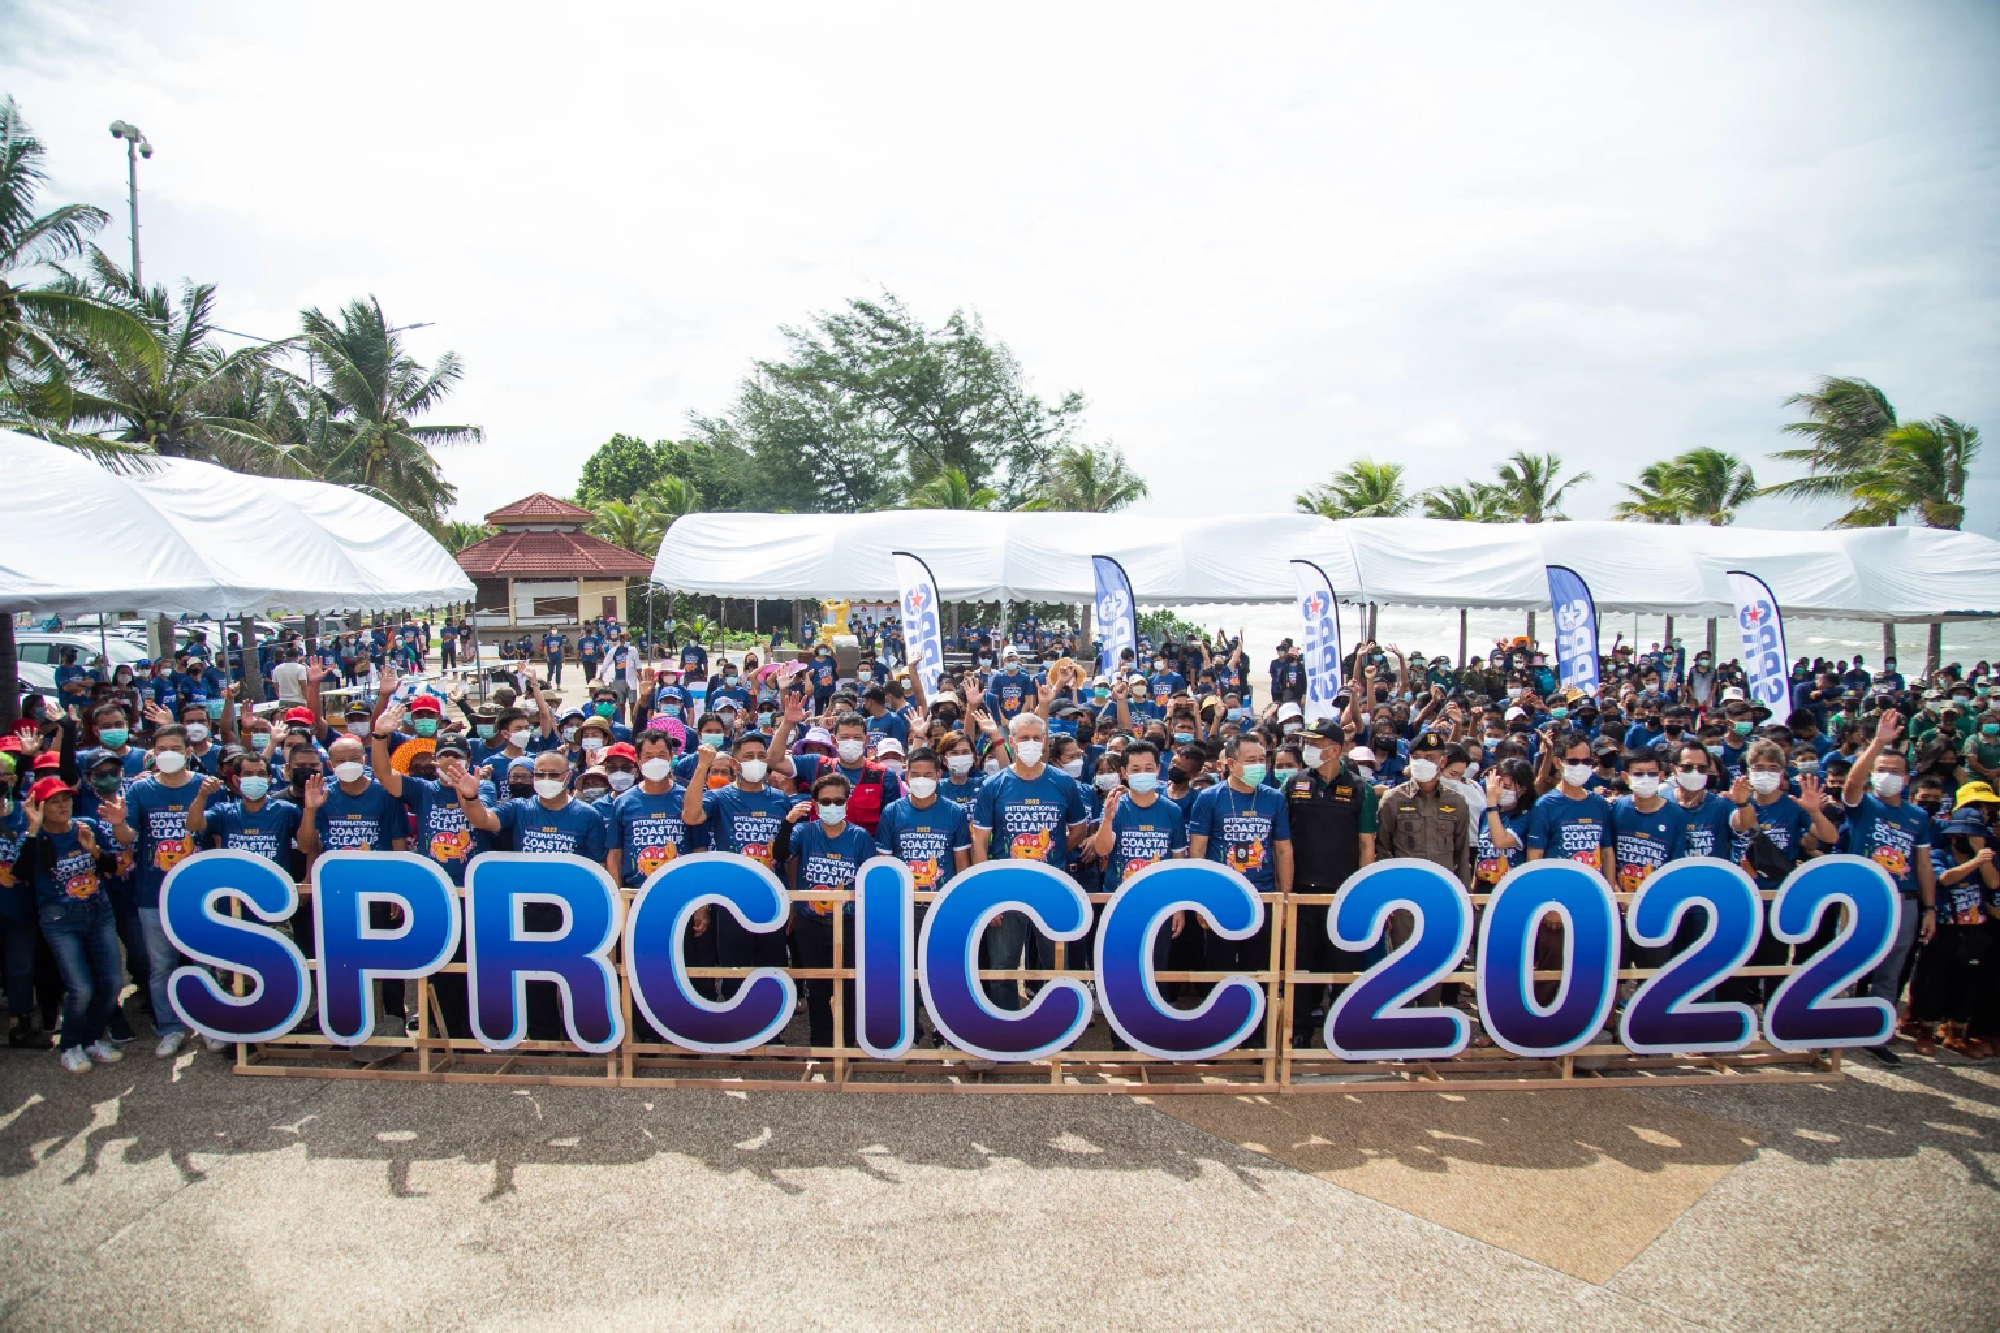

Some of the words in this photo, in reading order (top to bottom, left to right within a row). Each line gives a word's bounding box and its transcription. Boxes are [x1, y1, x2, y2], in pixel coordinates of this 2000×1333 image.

[1005, 812, 1060, 822] COASTAL
[150, 819, 187, 829] COAS
[734, 823, 780, 833] COASTA
[1006, 822, 1058, 832] CLEANUP
[1223, 824, 1272, 833] COASTAL
[329, 828, 379, 836] COASTAL
[633, 826, 685, 837] COASTAL
[330, 836, 379, 846] CLEANUP
[633, 836, 684, 846] CLEANUP
[900, 841, 945, 849] COASTAL
[1121, 837, 1169, 848] COASTAL
[1562, 841, 1599, 850] CLEAN
[902, 849, 945, 859] CLEANUP
[160, 849, 797, 1053] SPRC
[855, 856, 1266, 1061] ICC
[1323, 853, 1900, 1061] 2022
